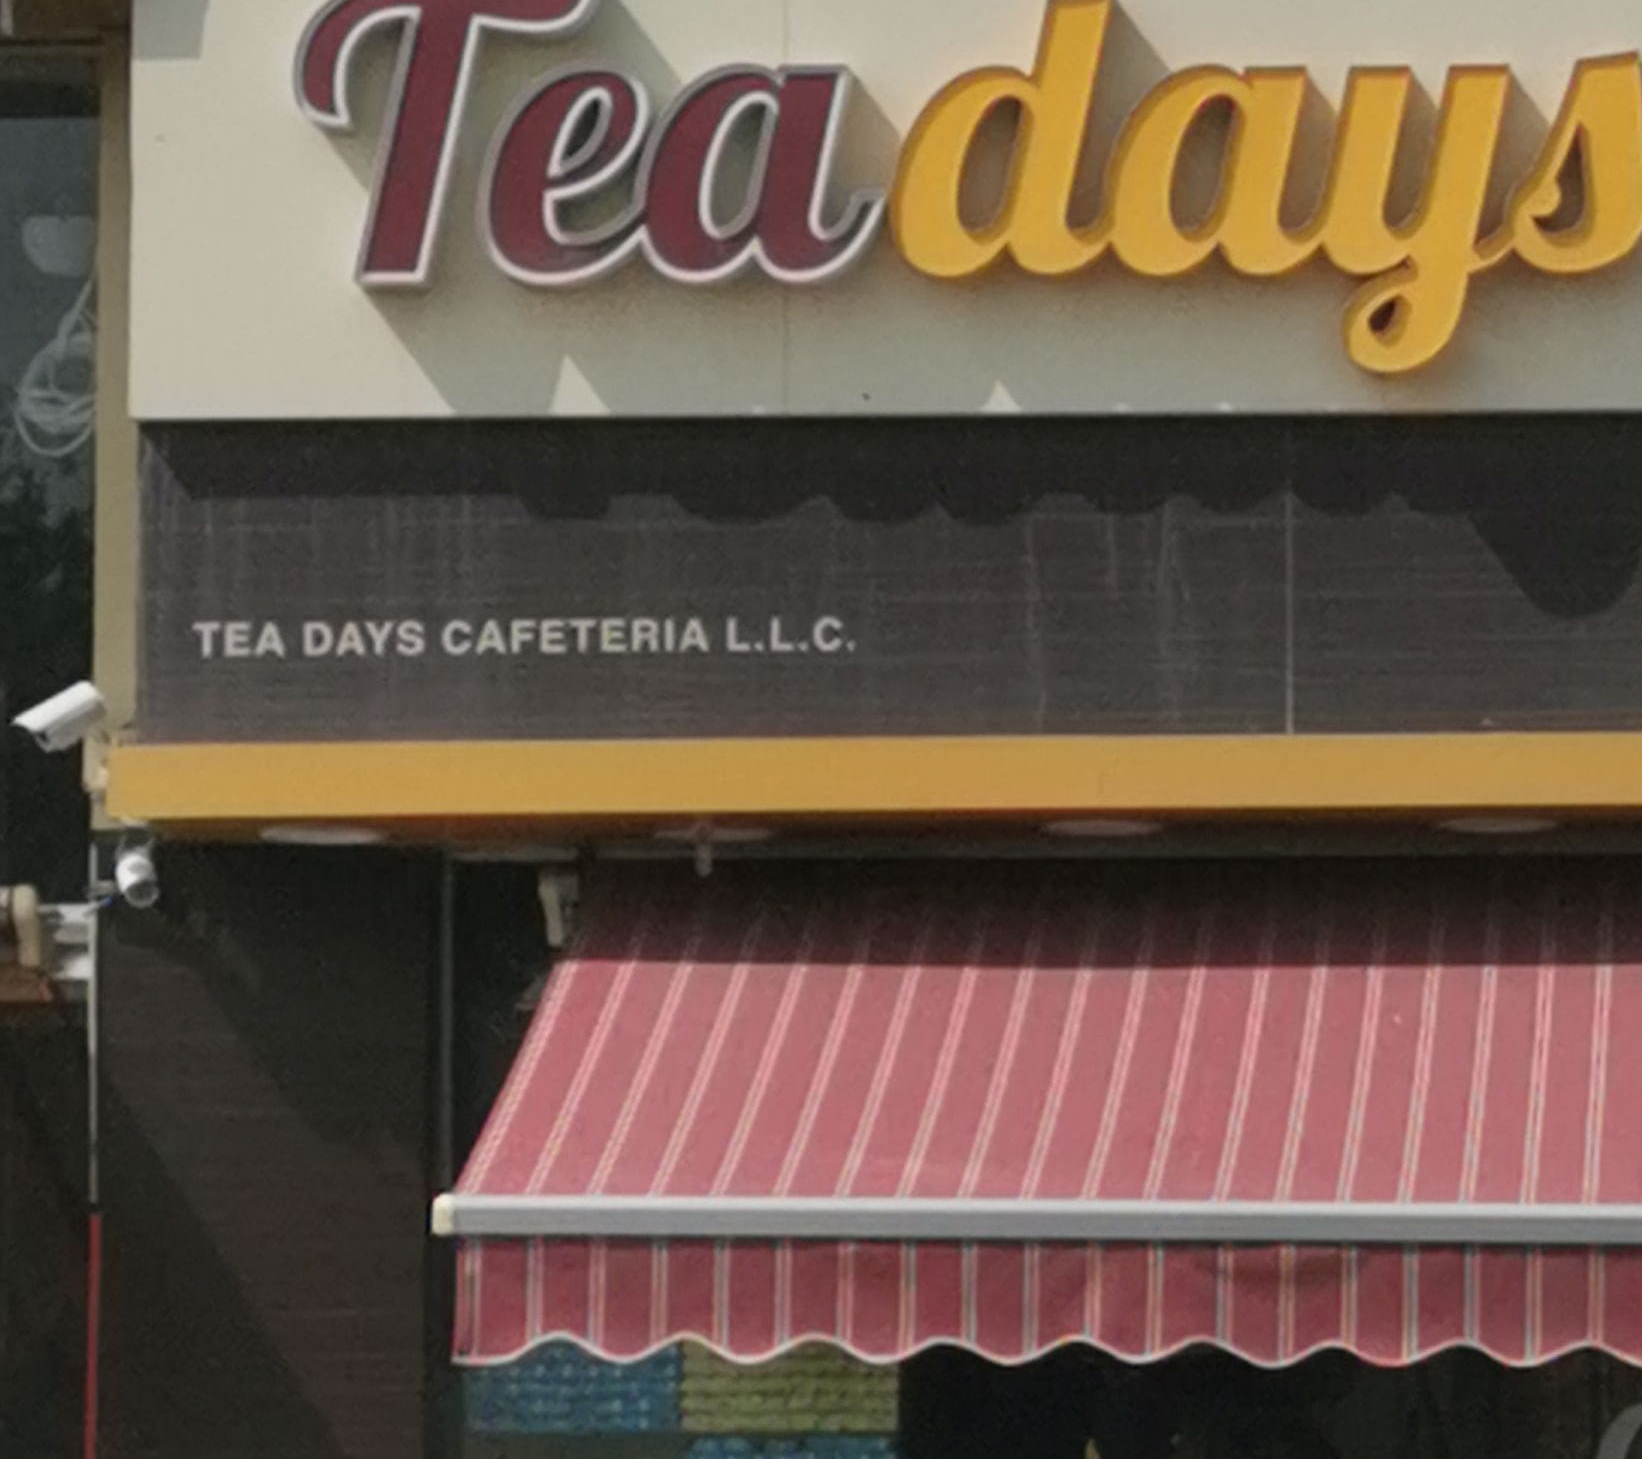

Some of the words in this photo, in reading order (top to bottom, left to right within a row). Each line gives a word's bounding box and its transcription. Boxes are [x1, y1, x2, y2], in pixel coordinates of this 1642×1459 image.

[193, 621, 286, 658] TEA
[301, 620, 425, 657] DAYS
[441, 618, 709, 655] CAFETERIA
[725, 616, 856, 653] L.L.C.
